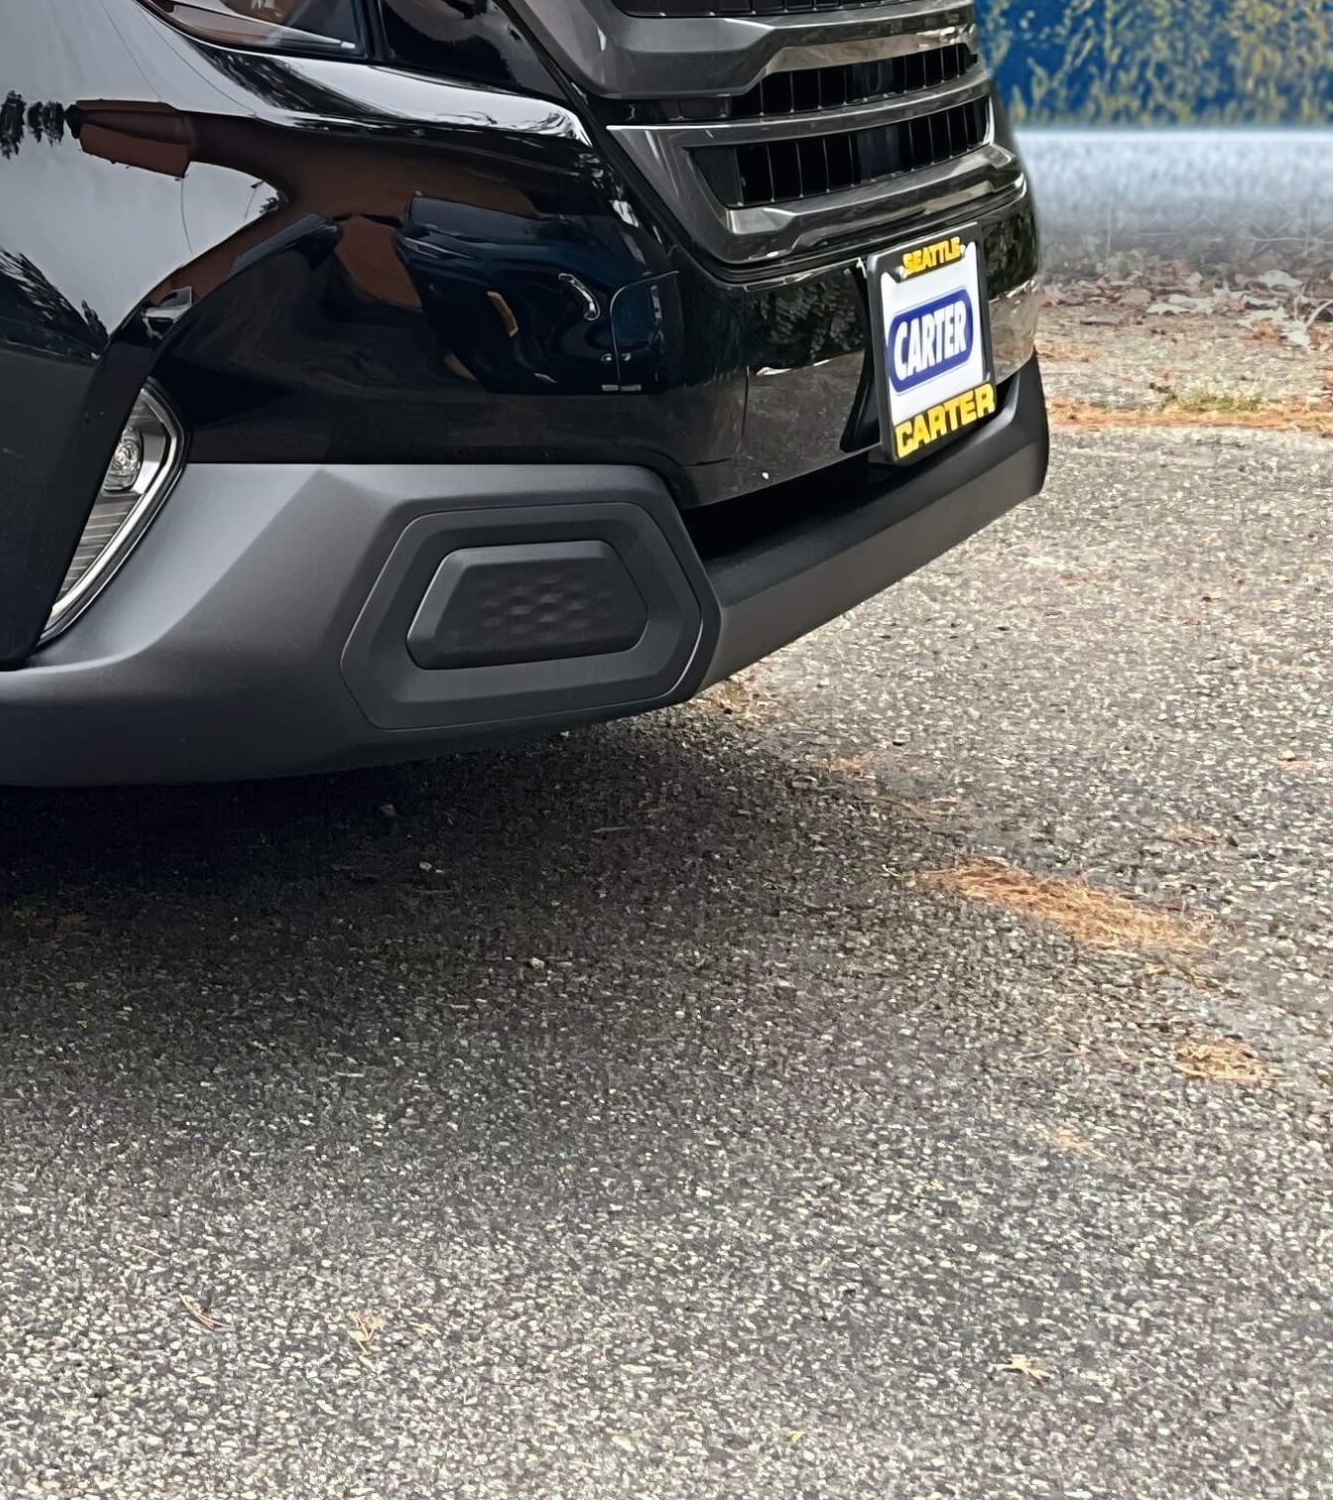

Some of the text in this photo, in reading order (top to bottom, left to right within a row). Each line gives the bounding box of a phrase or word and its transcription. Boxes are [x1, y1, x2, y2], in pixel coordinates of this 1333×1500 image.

[902, 236, 962, 276] SEATTLE
[893, 300, 968, 381] CARTER
[894, 383, 996, 458] CARTER
